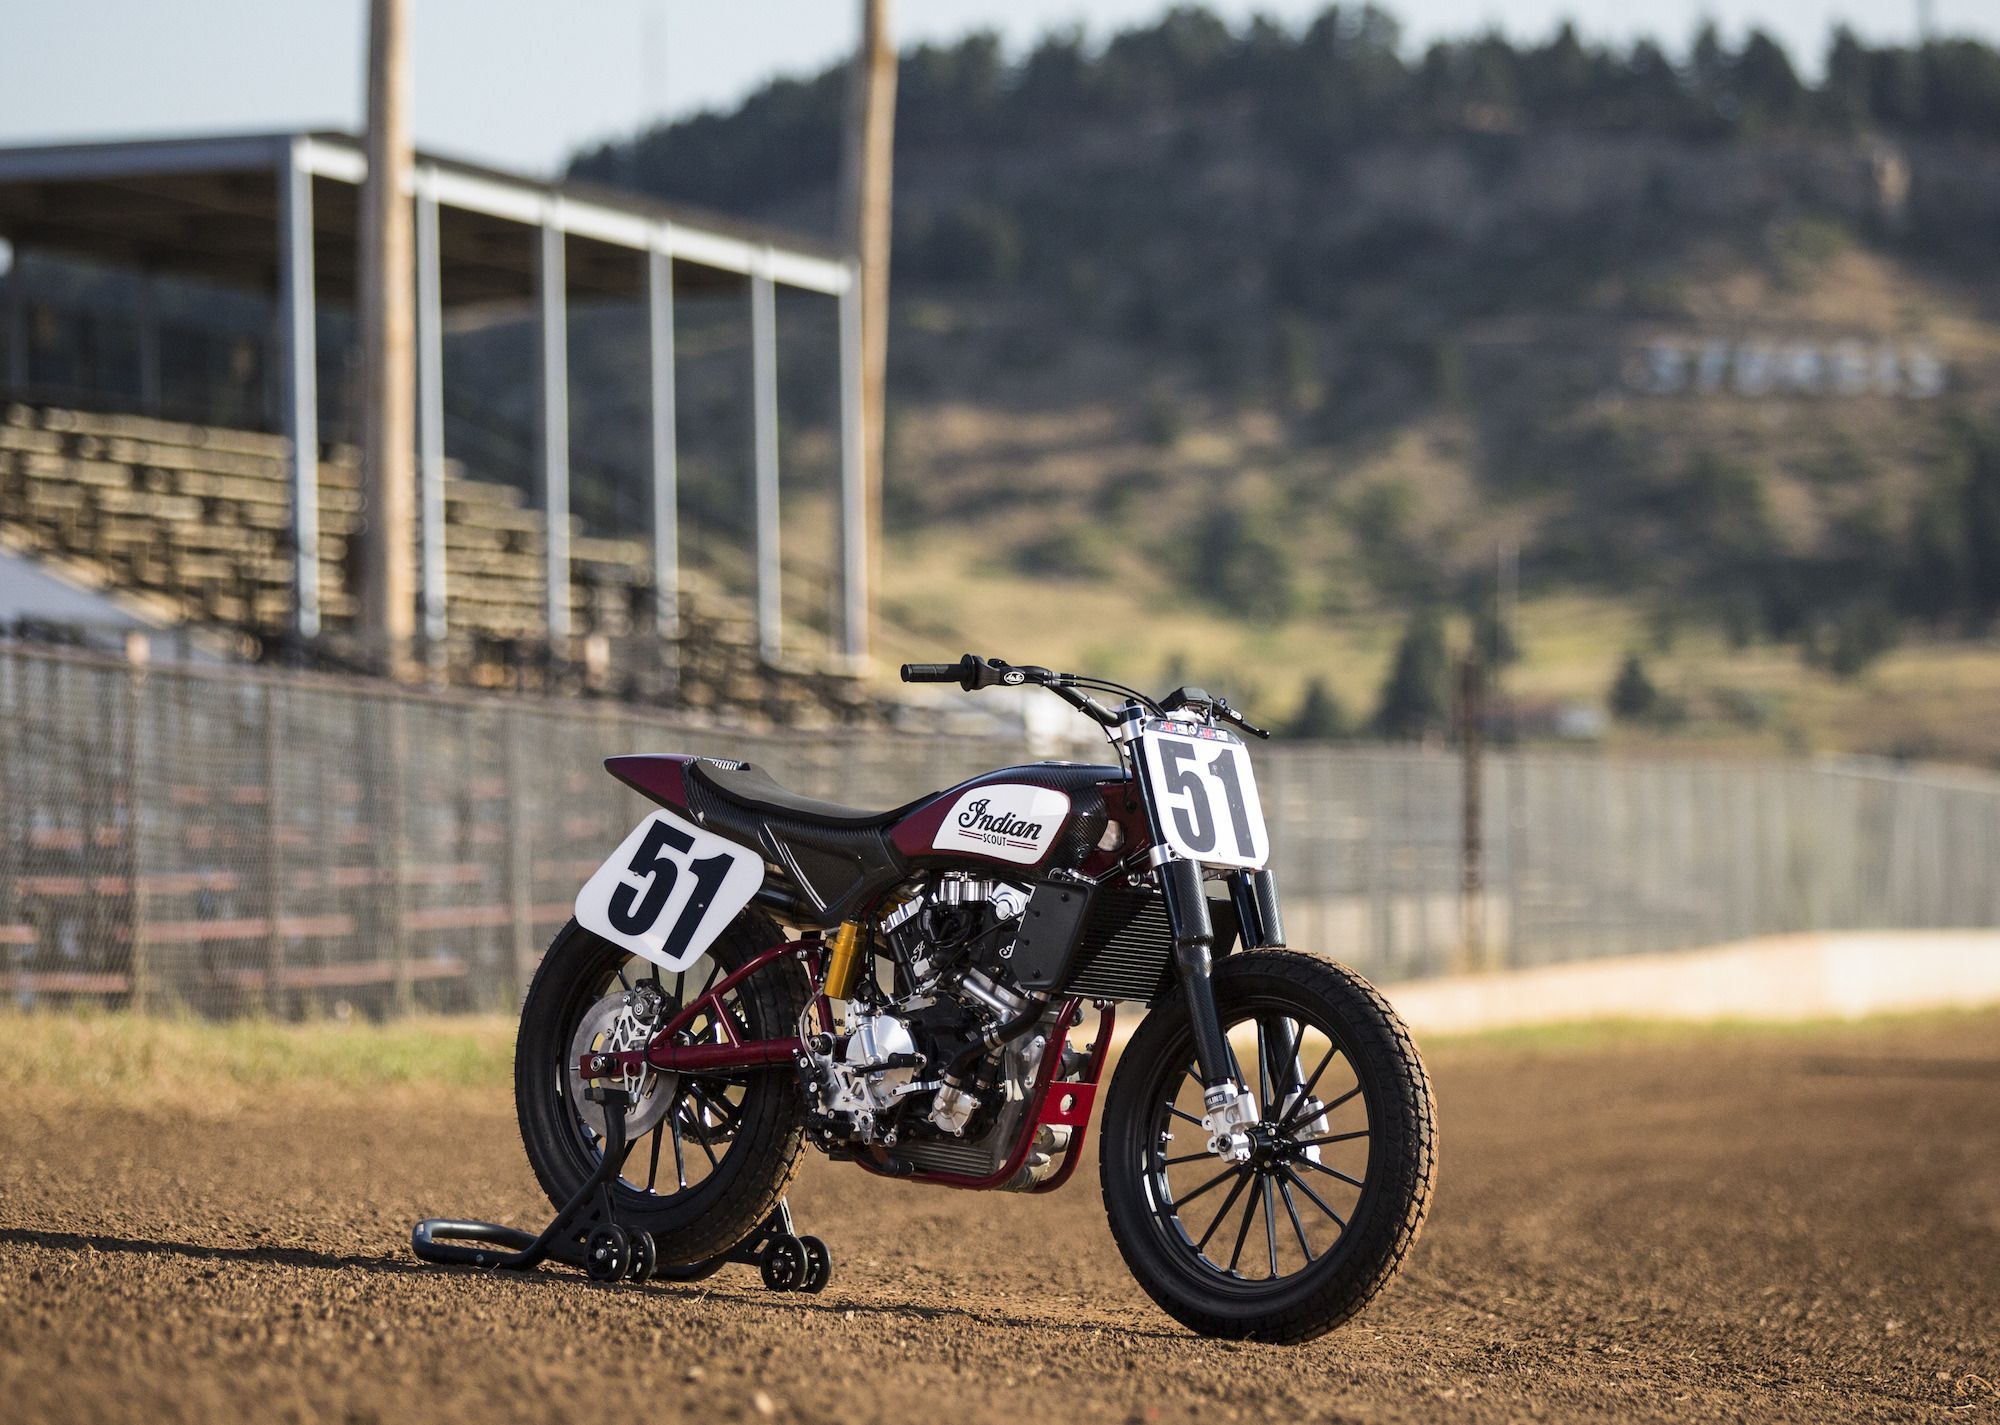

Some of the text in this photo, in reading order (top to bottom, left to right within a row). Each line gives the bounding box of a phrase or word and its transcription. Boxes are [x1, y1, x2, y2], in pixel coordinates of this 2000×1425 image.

[958, 798, 1043, 841] Indian
[982, 832, 1008, 847] SCOUT
[1157, 738, 1256, 859] 51
[607, 818, 736, 960] 51
